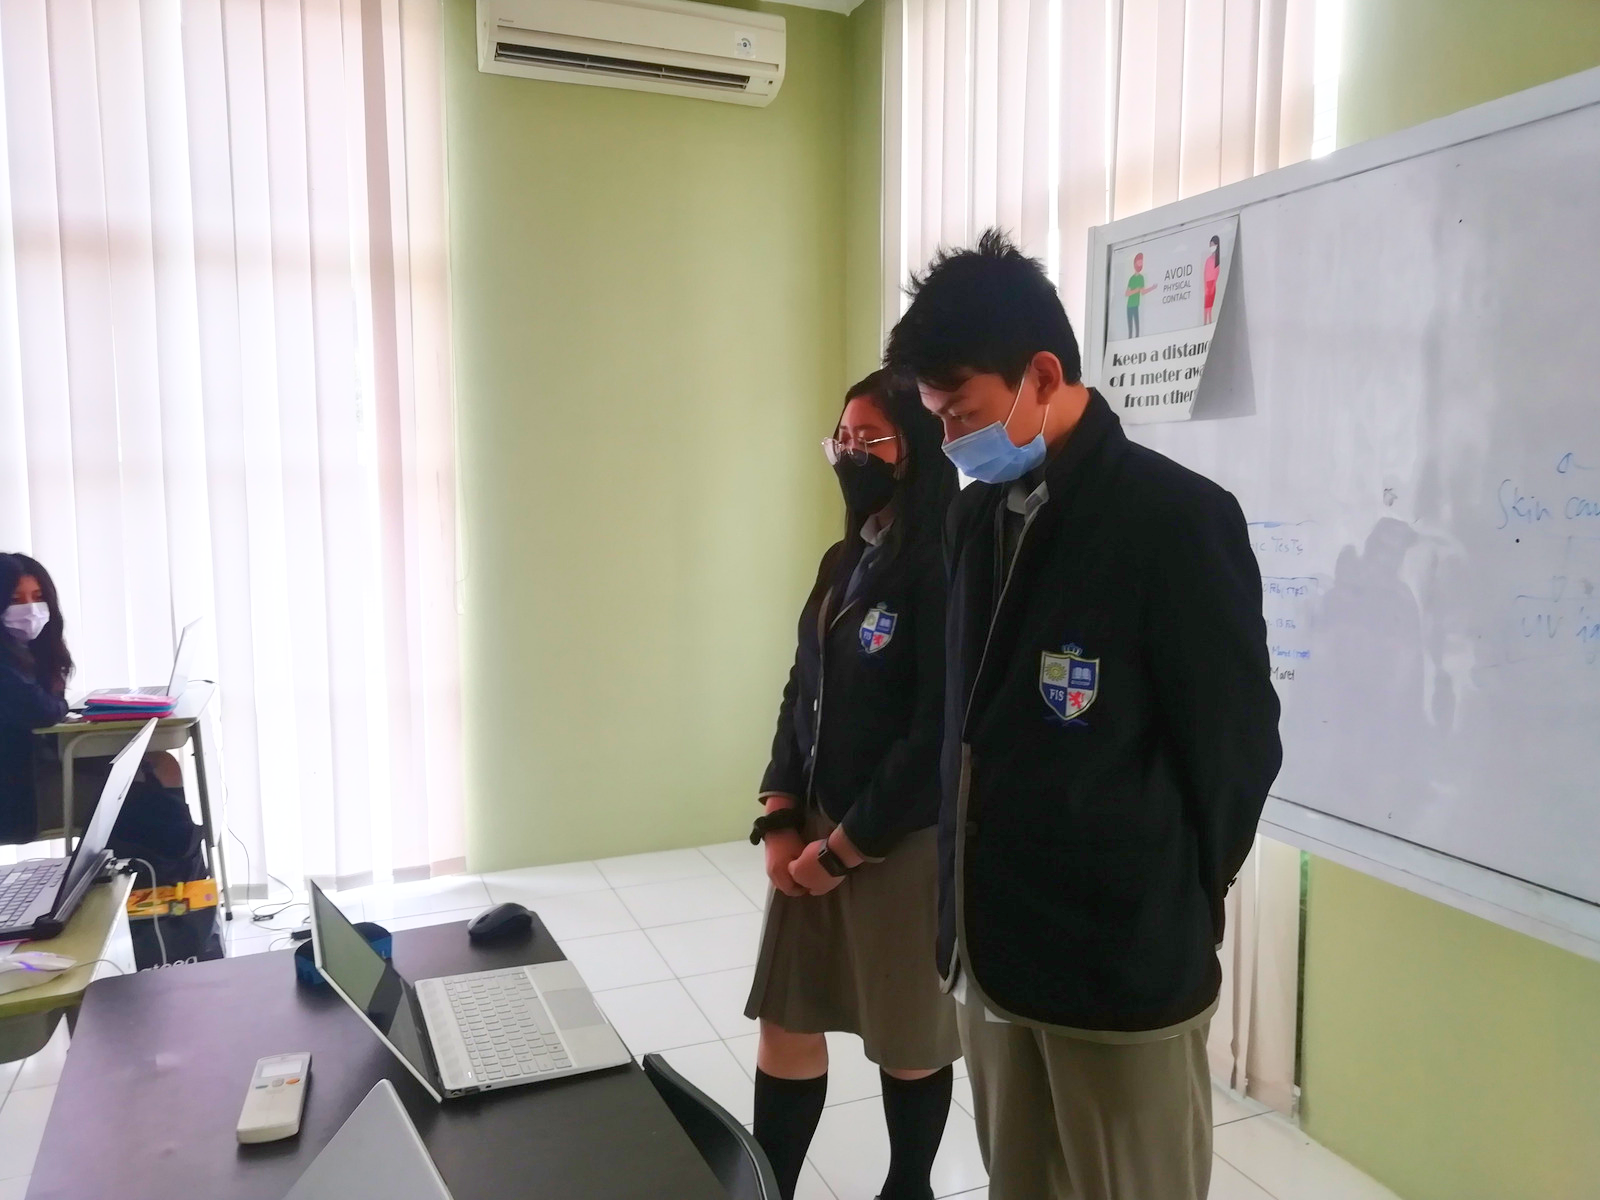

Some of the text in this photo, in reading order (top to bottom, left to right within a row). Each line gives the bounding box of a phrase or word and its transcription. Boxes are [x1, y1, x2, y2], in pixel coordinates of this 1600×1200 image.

[1164, 264, 1193, 281] AVOID
[1163, 280, 1191, 293] PHYSICAL
[1162, 291, 1191, 304] CONTACT
[1112, 352, 1147, 367] keep
[1150, 350, 1158, 362] a
[1109, 373, 1126, 388] of
[1140, 368, 1182, 386] meter
[1124, 393, 1160, 408] from
[1049, 688, 1065, 702] FIS
